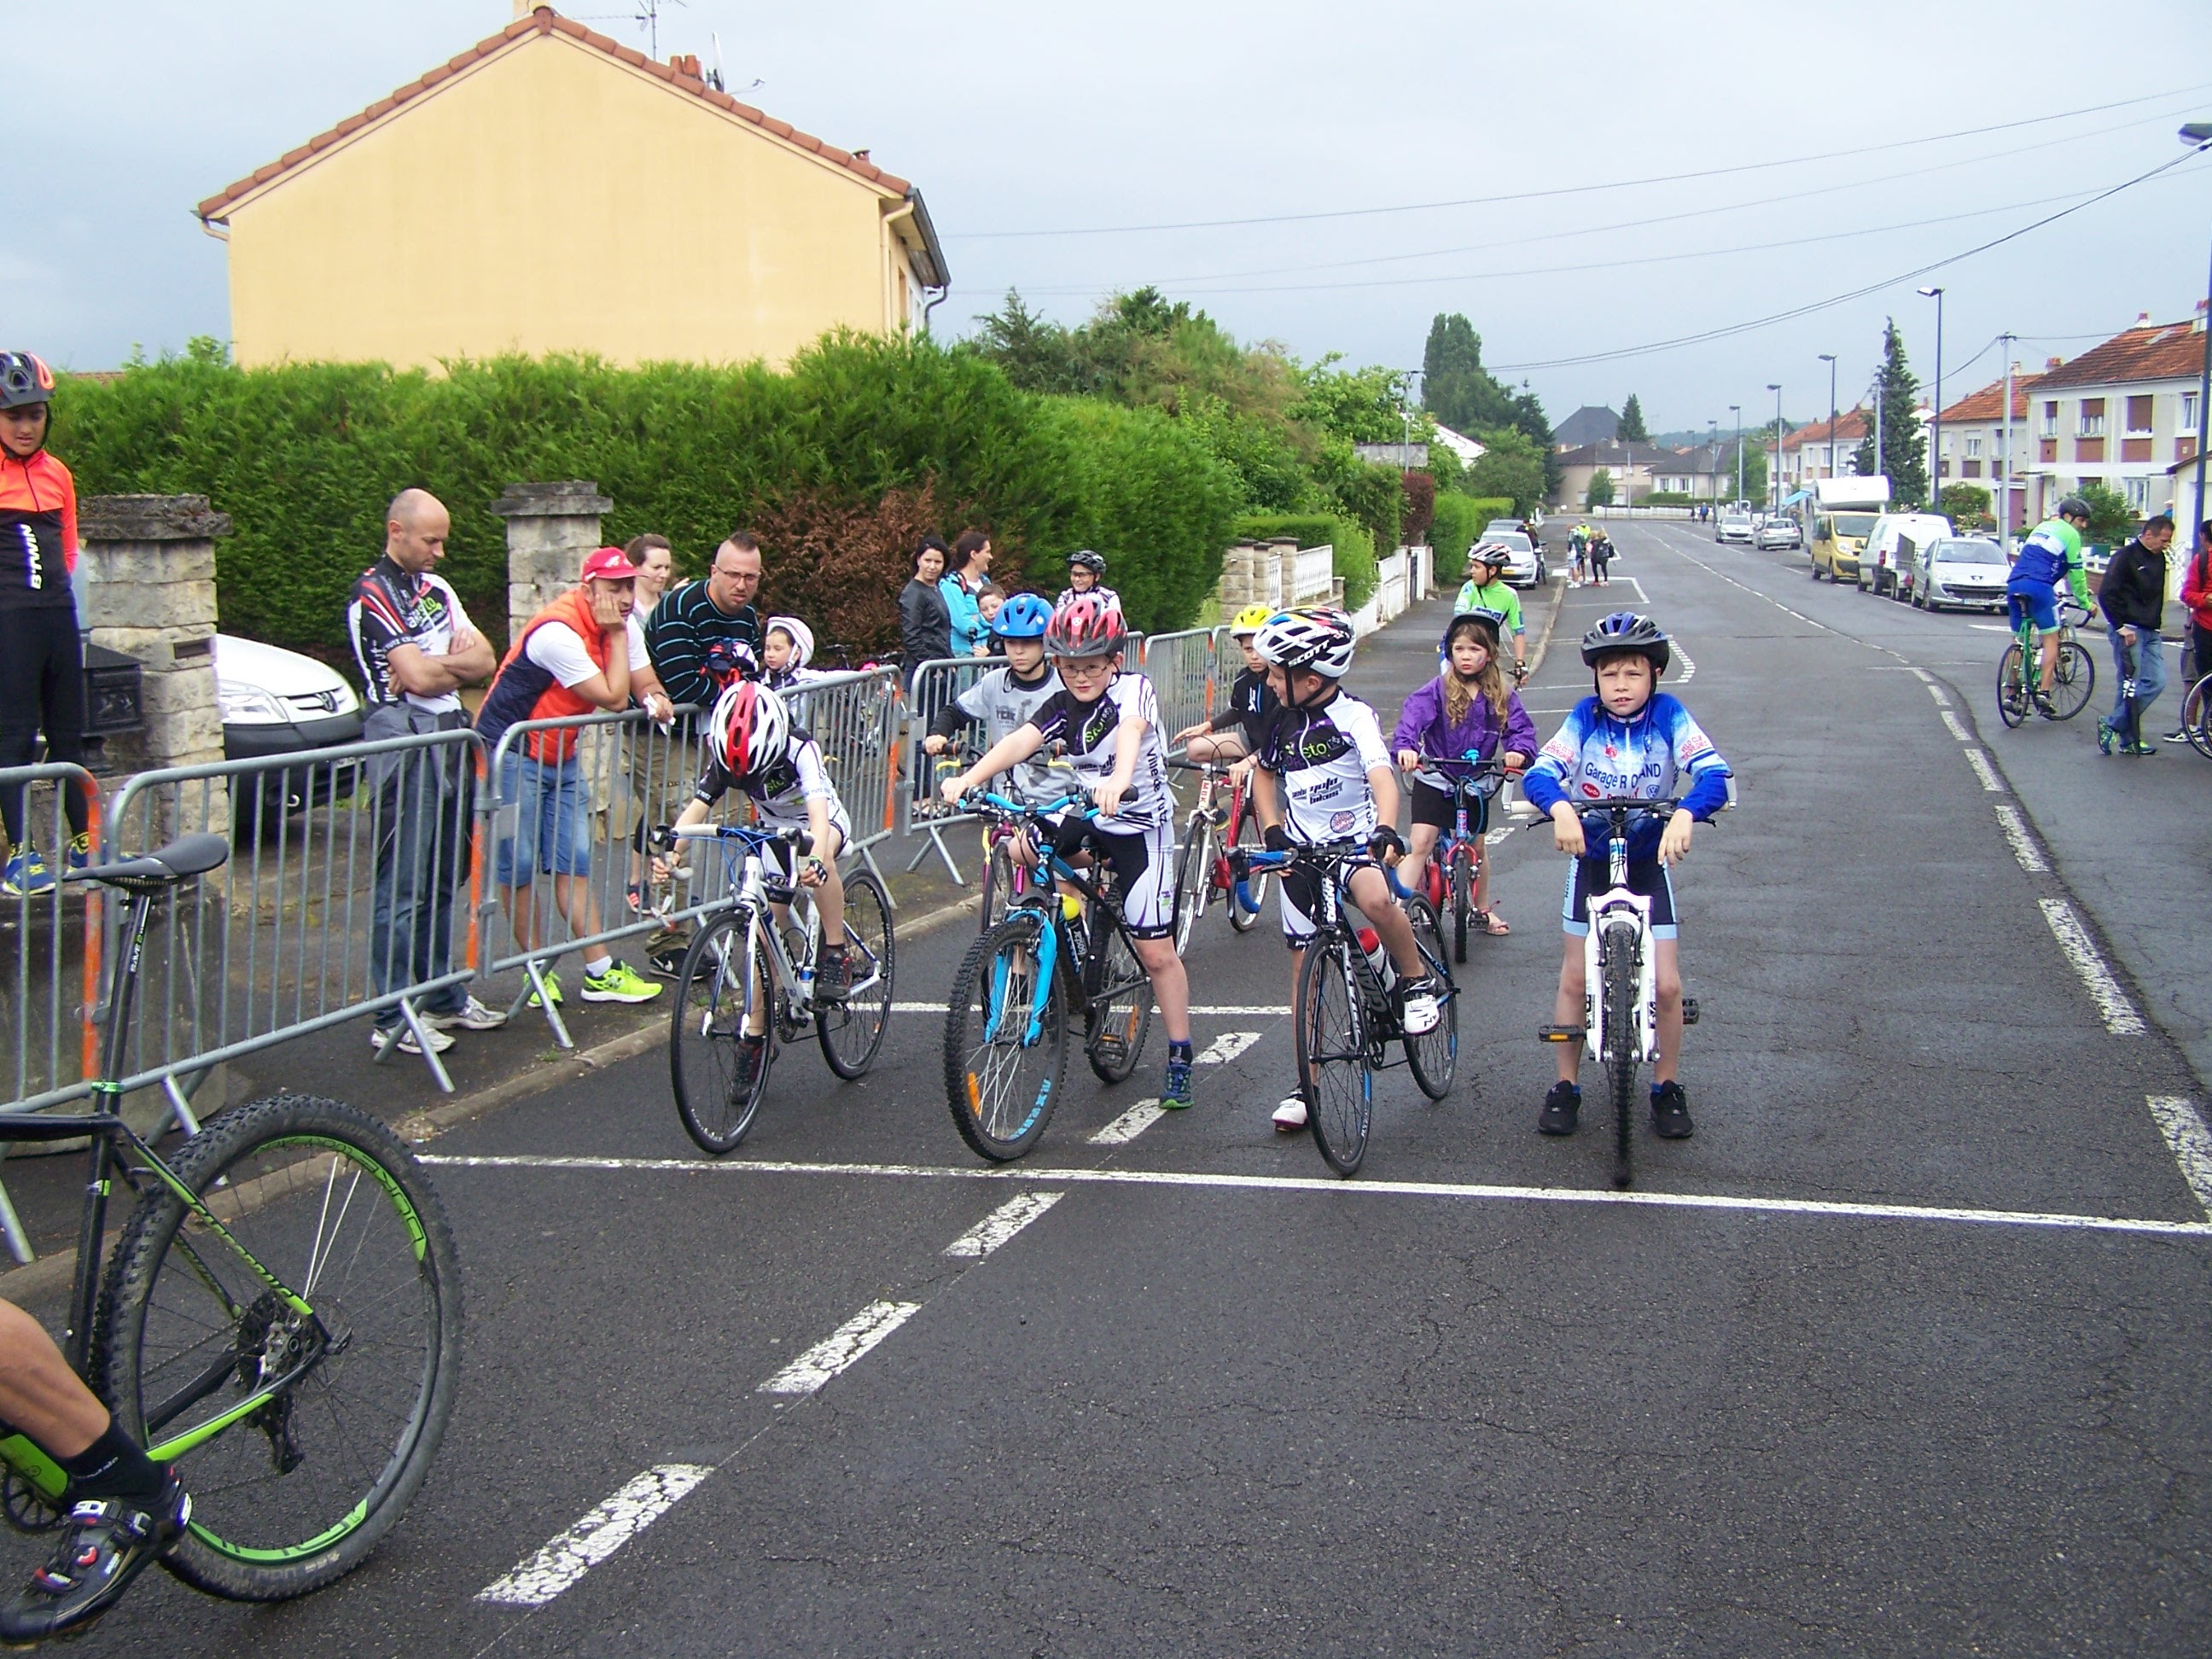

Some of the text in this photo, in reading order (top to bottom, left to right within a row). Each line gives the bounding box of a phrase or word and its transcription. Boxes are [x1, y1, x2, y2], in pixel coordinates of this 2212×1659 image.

[20, 523, 43, 590] B'TWIN
[1146, 747, 1159, 777] Ville
[1153, 778, 1161, 793] de
[1200, 782, 1210, 803] MBK
[1585, 761, 1619, 789] Garage
[1350, 947, 1388, 1014] GIANT
